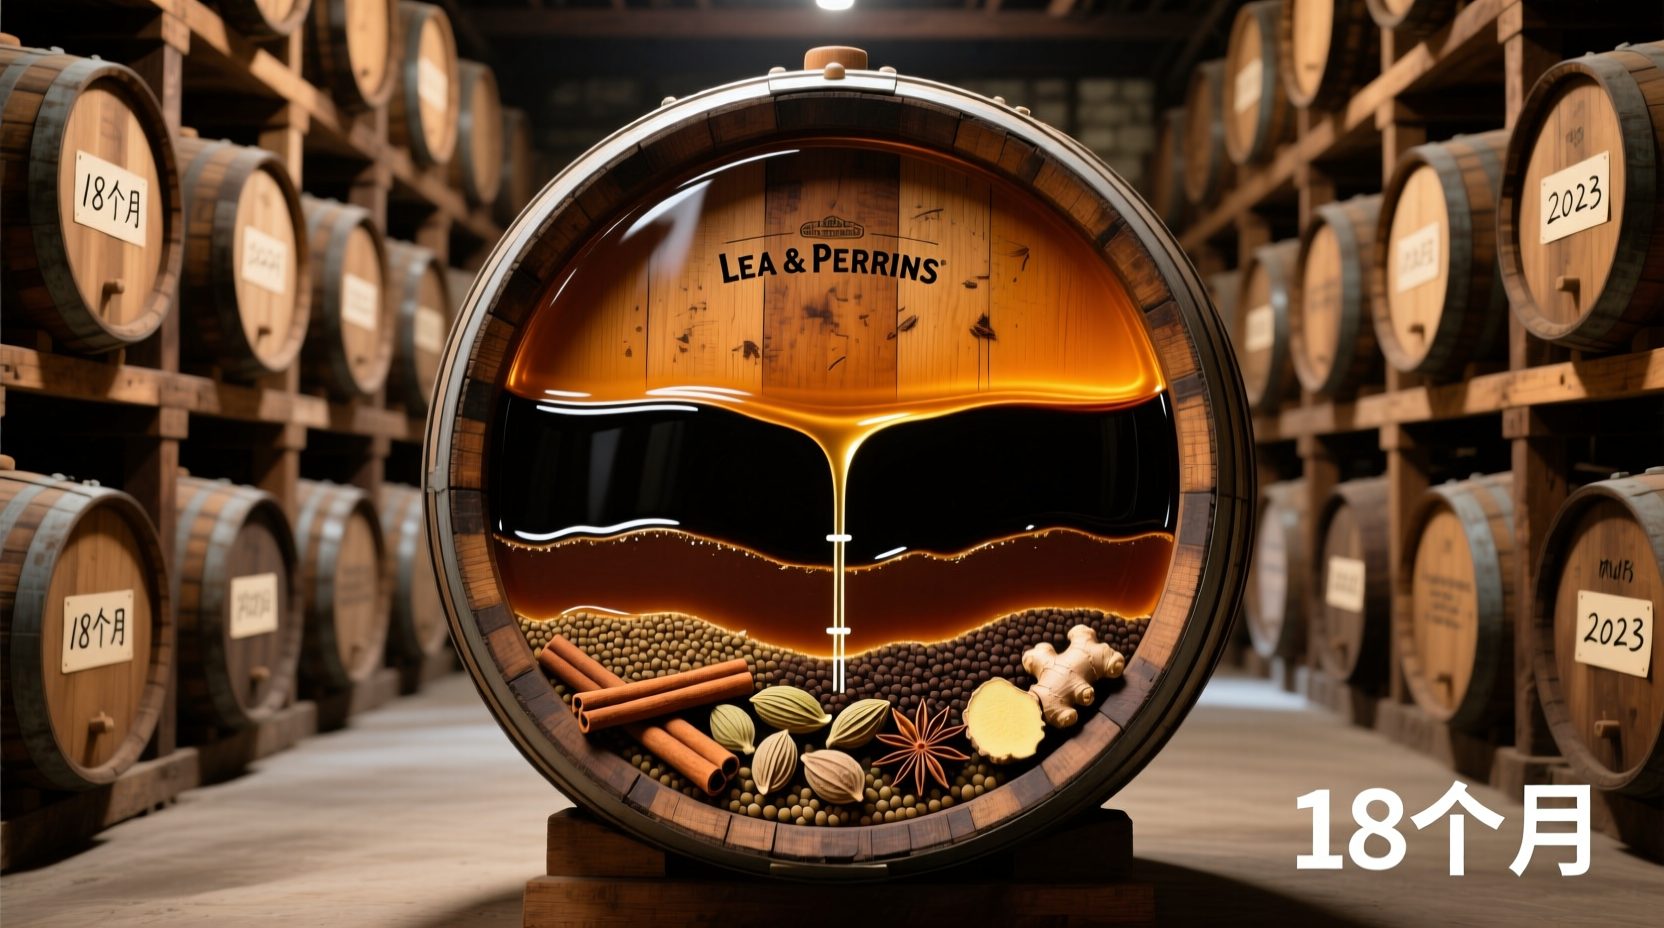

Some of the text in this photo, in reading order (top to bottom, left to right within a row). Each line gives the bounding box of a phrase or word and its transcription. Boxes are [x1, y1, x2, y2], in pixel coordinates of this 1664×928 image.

[82, 173, 140, 229] 18个月
[1547, 175, 1603, 224] 2023
[719, 252, 777, 284] LEA
[783, 247, 807, 273] &
[70, 607, 125, 650] 18个月
[1583, 613, 1645, 652] 2023
